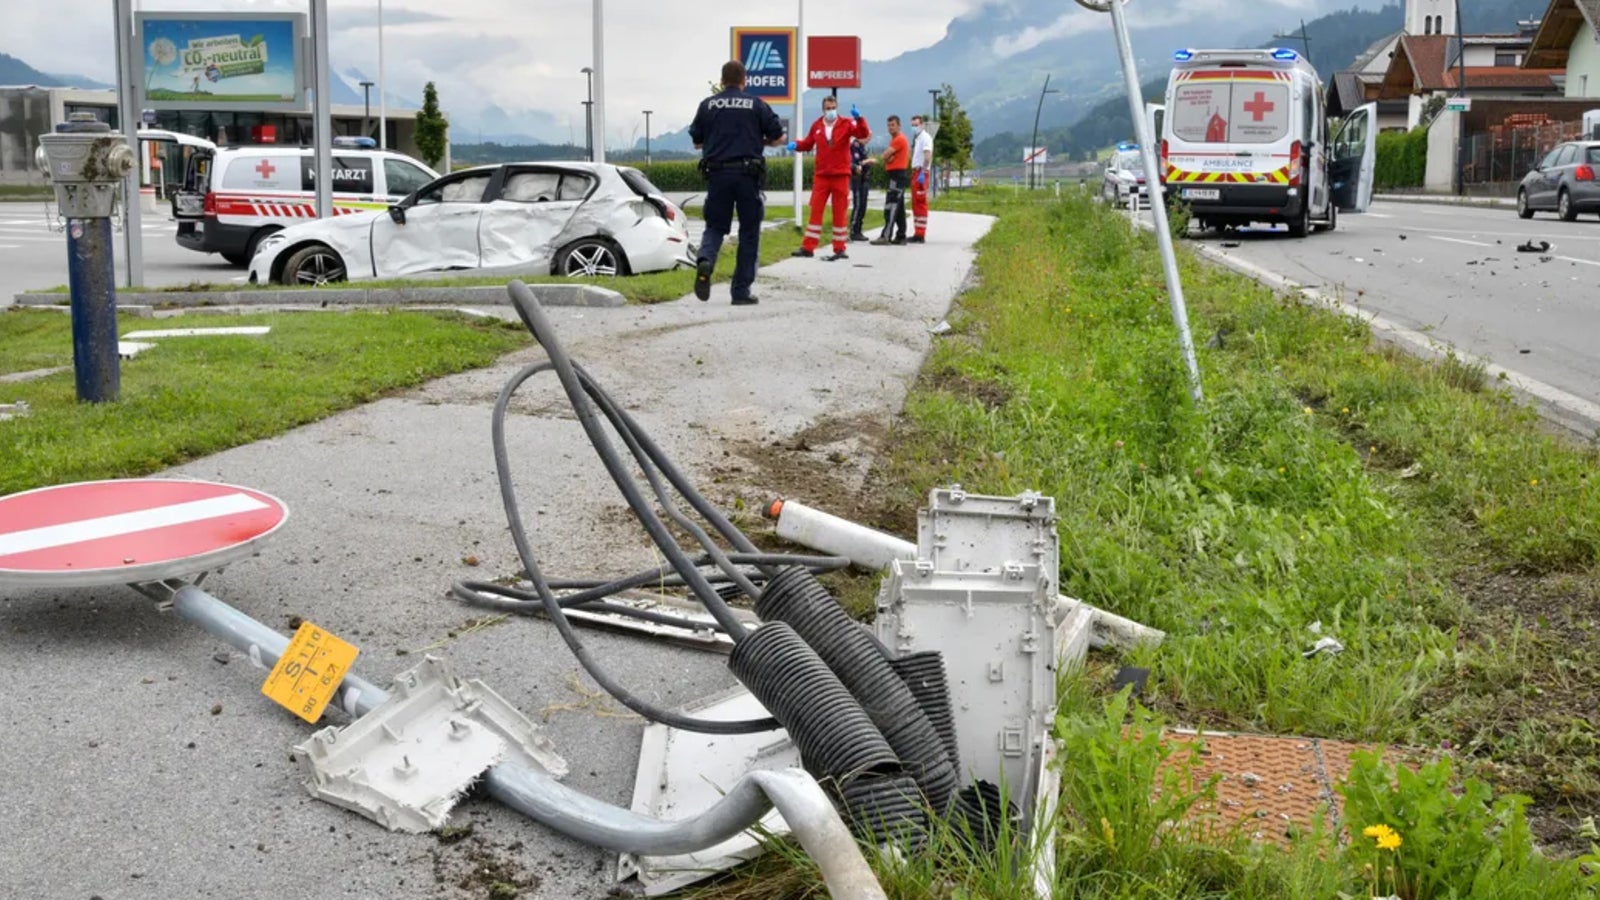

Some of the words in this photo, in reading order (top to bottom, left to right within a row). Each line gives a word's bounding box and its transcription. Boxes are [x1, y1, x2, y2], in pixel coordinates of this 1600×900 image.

[207, 38, 239, 47] arbeiten
[810, 70, 854, 80] MPREIS
[744, 75, 785, 87] HOFER
[708, 97, 754, 110] POLIZEI
[1202, 160, 1254, 168] AMBULANCE
[308, 168, 367, 180] NTARZT
